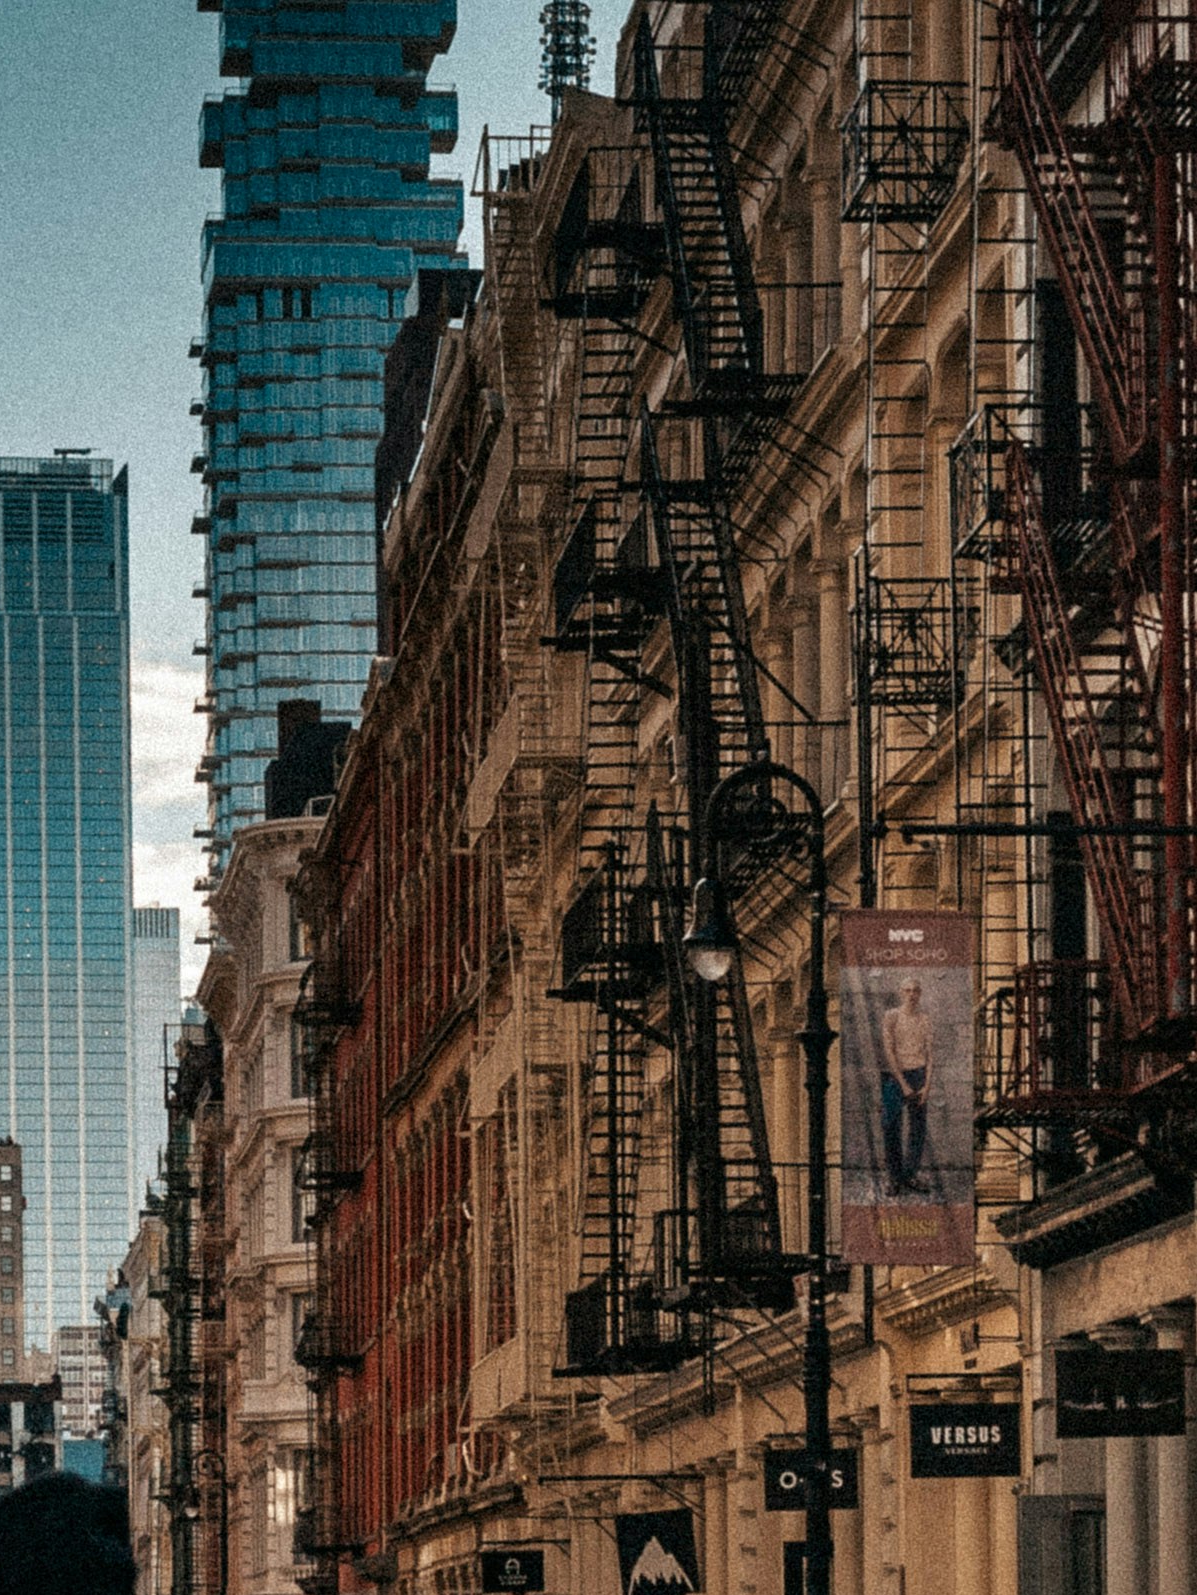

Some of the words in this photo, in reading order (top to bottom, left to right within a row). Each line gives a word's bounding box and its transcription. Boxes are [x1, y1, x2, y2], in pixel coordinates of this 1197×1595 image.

[888, 928, 924, 943] NYC
[865, 948, 903, 961] SHOP
[907, 948, 948, 961] SOHO
[930, 1424, 1002, 1446] VERSUS
